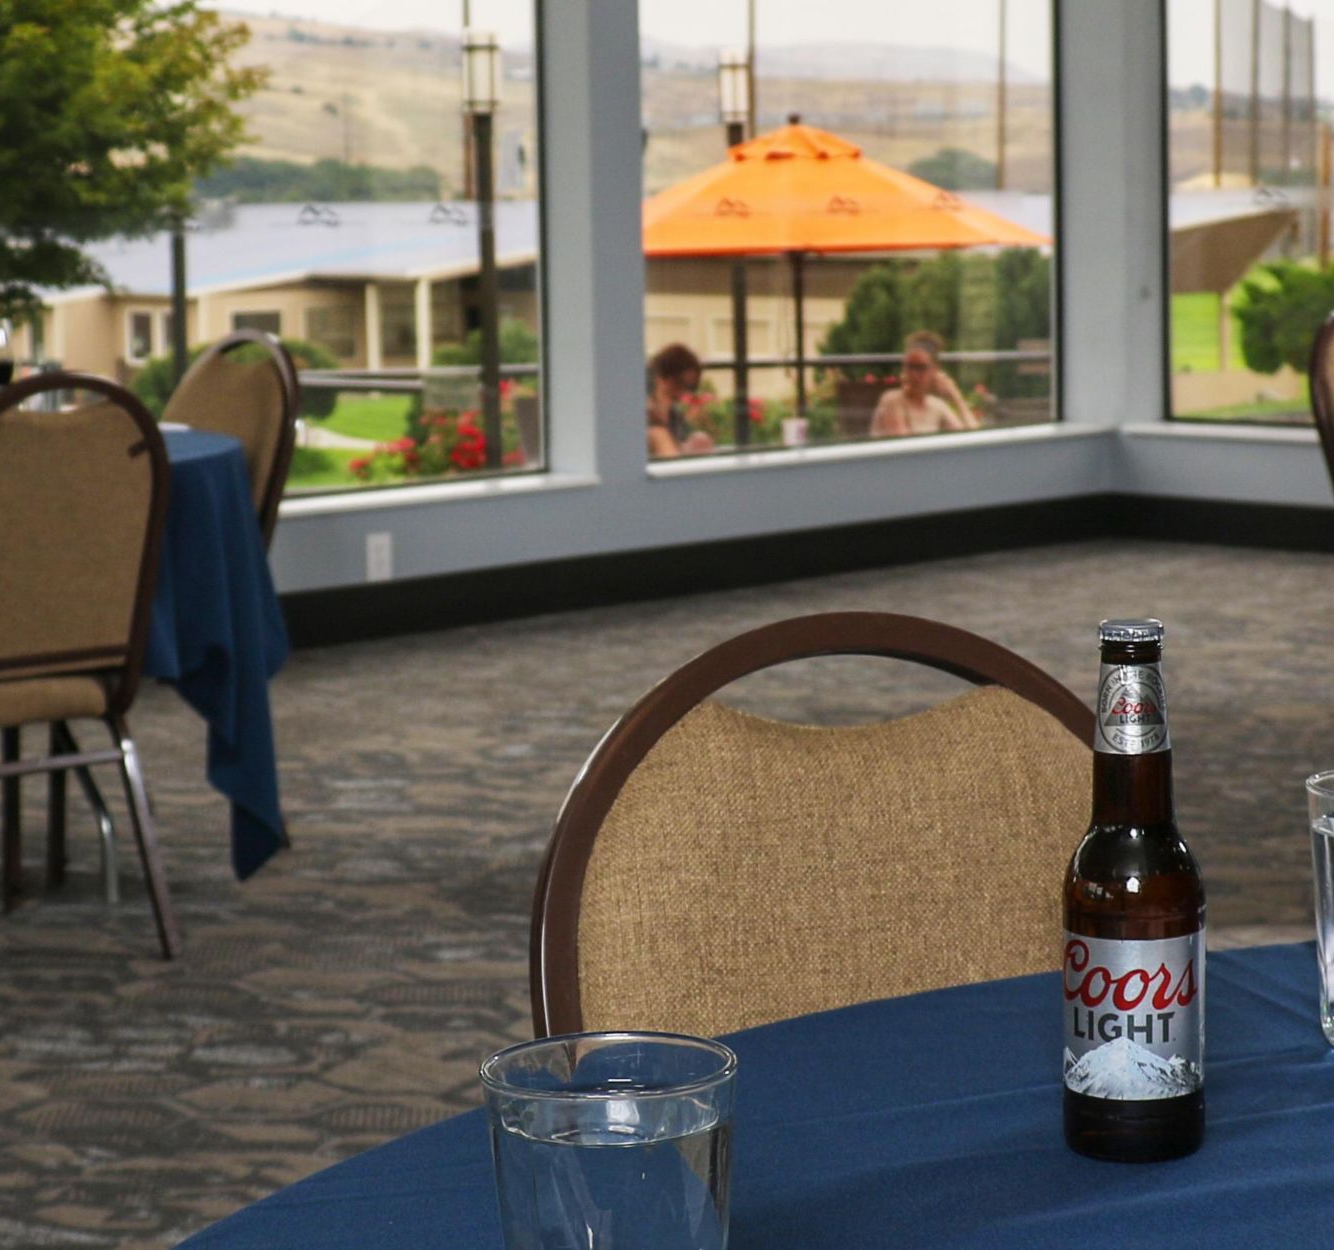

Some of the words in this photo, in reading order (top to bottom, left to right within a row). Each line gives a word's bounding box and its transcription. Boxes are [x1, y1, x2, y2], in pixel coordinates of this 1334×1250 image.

[1112, 697, 1157, 714] Coors
[1064, 939, 1198, 1012] Coors
[1074, 1007, 1176, 1044] LIGHT
